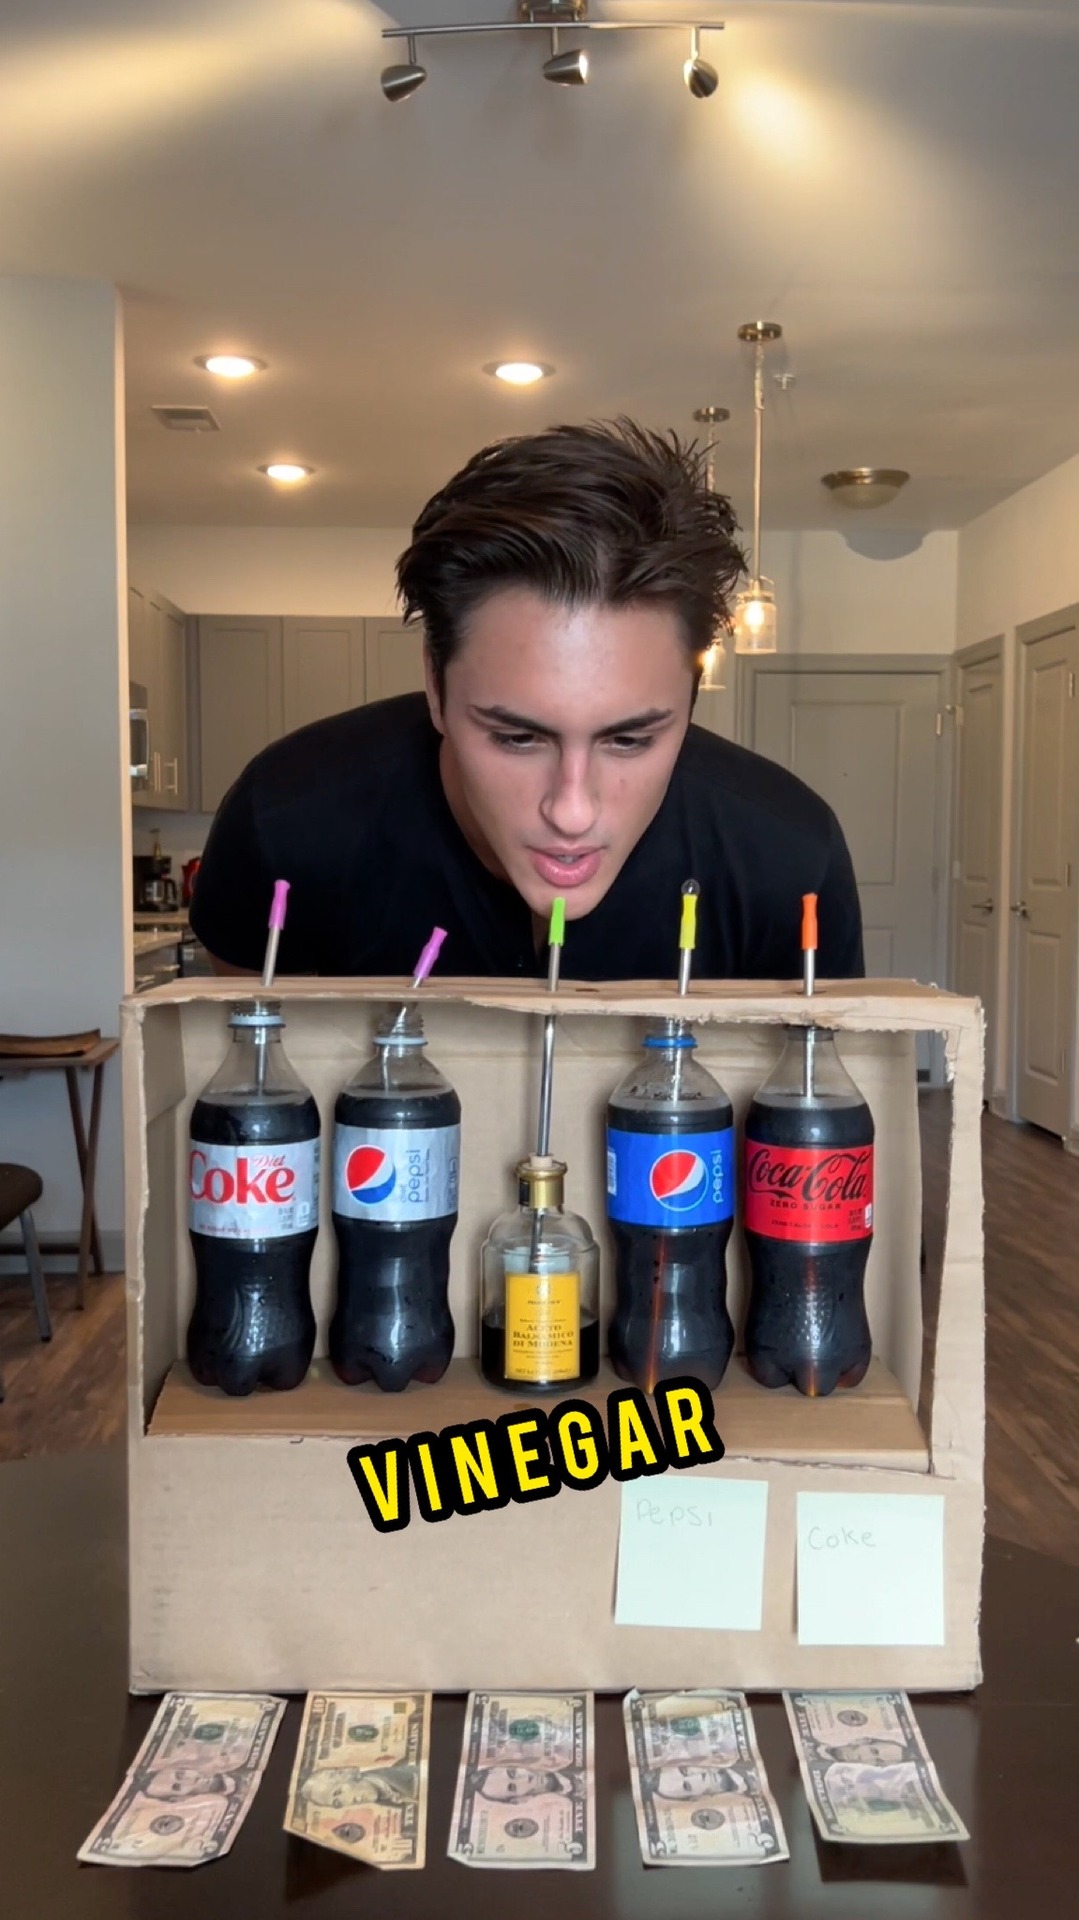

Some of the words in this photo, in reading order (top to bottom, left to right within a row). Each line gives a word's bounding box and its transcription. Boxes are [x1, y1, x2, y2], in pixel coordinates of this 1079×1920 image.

[253, 1155, 286, 1167] Diet
[405, 1149, 423, 1203] pepsi
[749, 1149, 870, 1202] Coca-Cola
[190, 1150, 296, 1205] Coke
[709, 1149, 723, 1204] pepsi
[769, 1199, 798, 1209] ZERO
[803, 1202, 841, 1211] SUGAR
[636, 1499, 713, 1527] Pepsi
[807, 1526, 877, 1550] Coke
[574, 1711, 584, 1768] DOLLARS
[404, 1803, 415, 1826] TEN
[574, 1802, 584, 1832] FIVE
